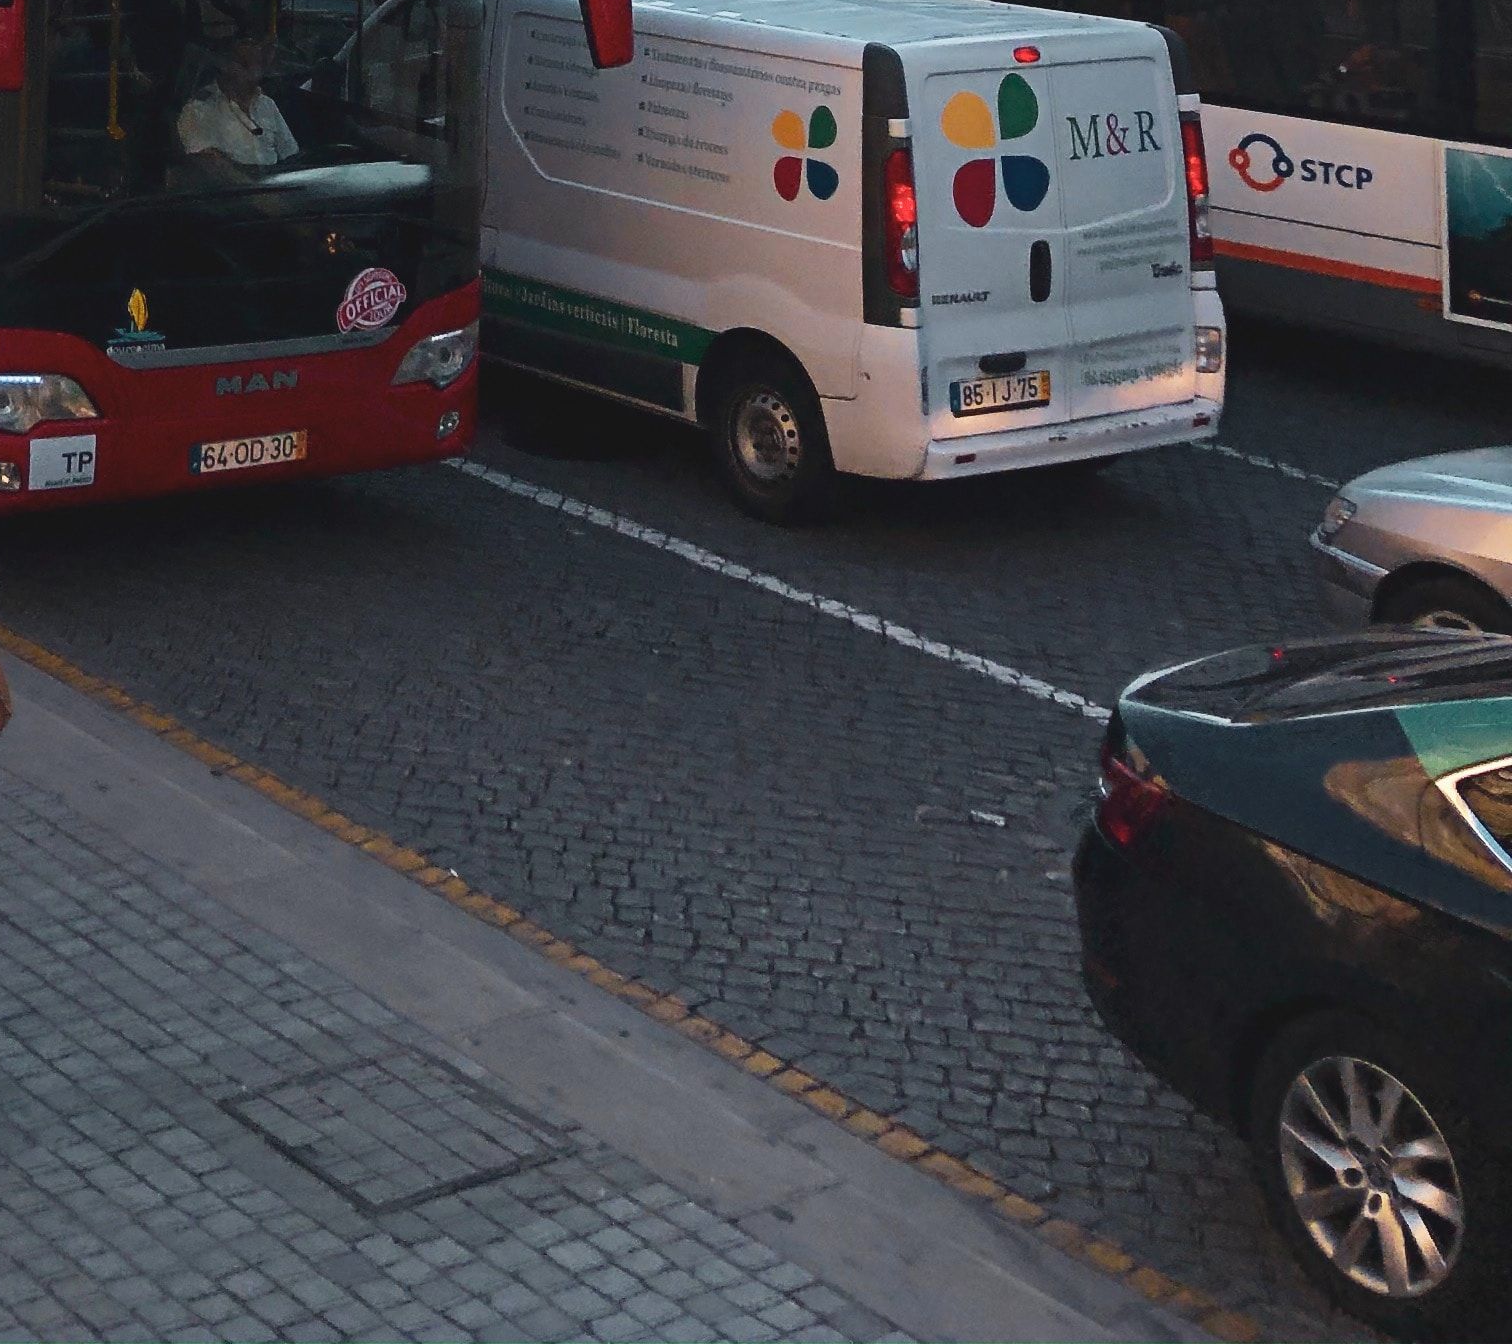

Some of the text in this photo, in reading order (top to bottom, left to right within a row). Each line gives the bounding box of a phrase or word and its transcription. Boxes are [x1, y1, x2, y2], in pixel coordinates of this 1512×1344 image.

[808, 80, 842, 97] pragas
[1300, 158, 1373, 190] STCP
[345, 285, 405, 321] OFFICIAL
[931, 290, 991, 306] RENAULT
[627, 316, 679, 348] Floresta
[215, 369, 299, 396] MAN
[62, 451, 94, 474] TP
